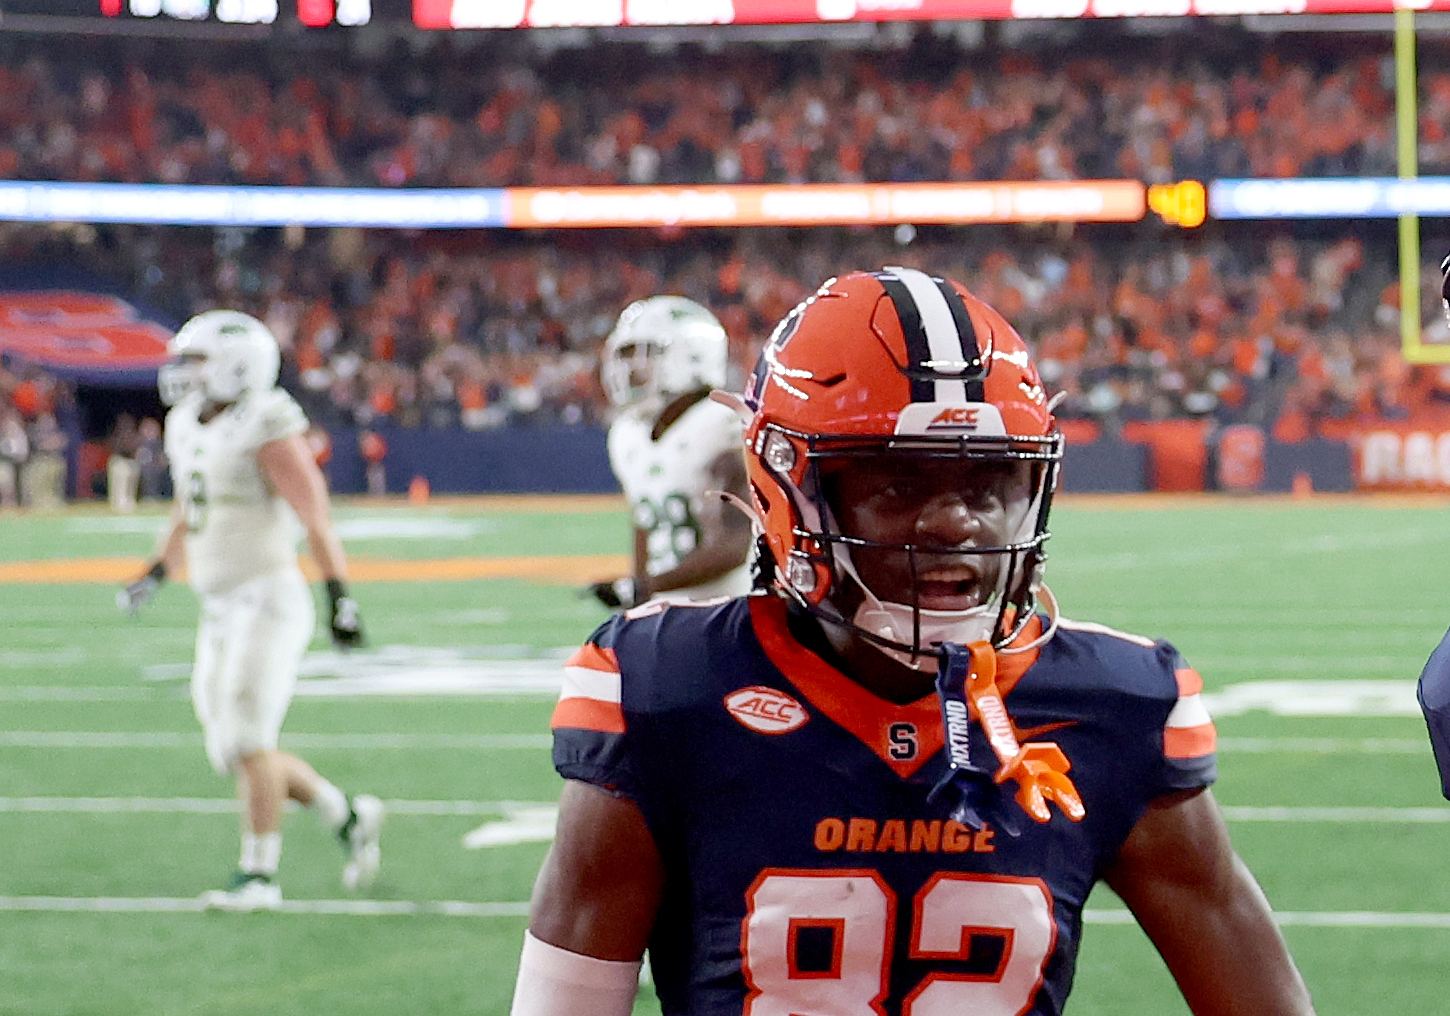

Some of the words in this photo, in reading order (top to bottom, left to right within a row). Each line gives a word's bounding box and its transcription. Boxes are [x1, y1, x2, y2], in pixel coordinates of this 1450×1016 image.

[931, 408, 980, 423] ACC
[738, 698, 797, 719] ACC
[887, 721, 918, 761] S
[945, 700, 971, 765] NXTRND
[814, 817, 996, 853] ORANGE
